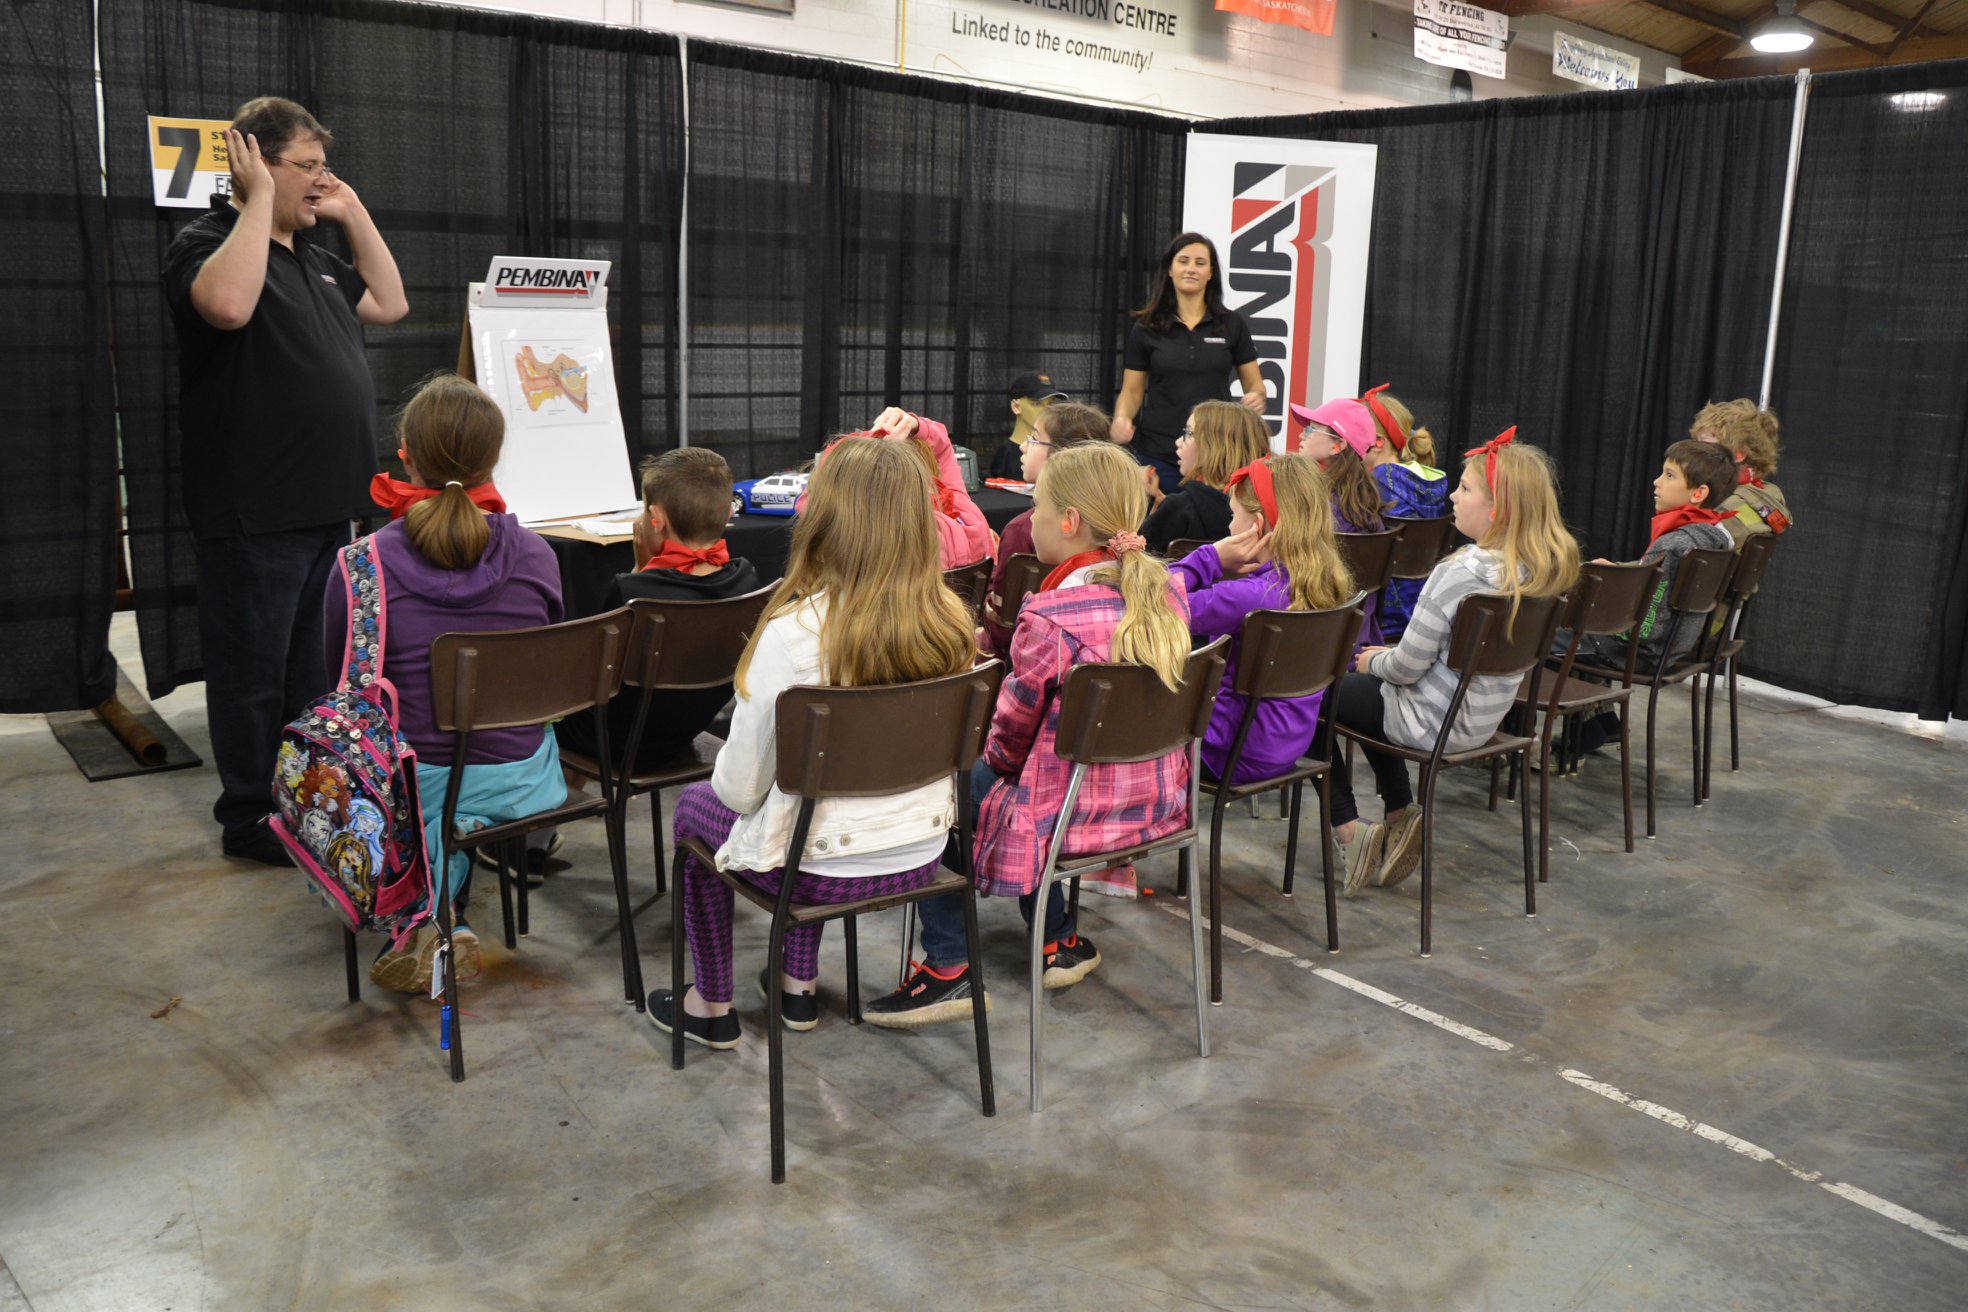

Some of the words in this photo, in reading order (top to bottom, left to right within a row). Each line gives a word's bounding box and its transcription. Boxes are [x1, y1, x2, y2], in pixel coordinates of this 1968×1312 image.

[1114, 2, 1177, 36] CENTRE
[1450, 4, 1485, 22] FENCING
[951, 12, 1010, 42] Linked
[1015, 25, 1031, 46] to
[1036, 29, 1060, 51] the
[1065, 38, 1154, 74] community!
[1447, 28, 1459, 38] ALL
[1615, 70, 1635, 89] You
[157, 126, 201, 199] 7
[495, 267, 588, 288] PEMBINA
[752, 493, 791, 503] POLICE
